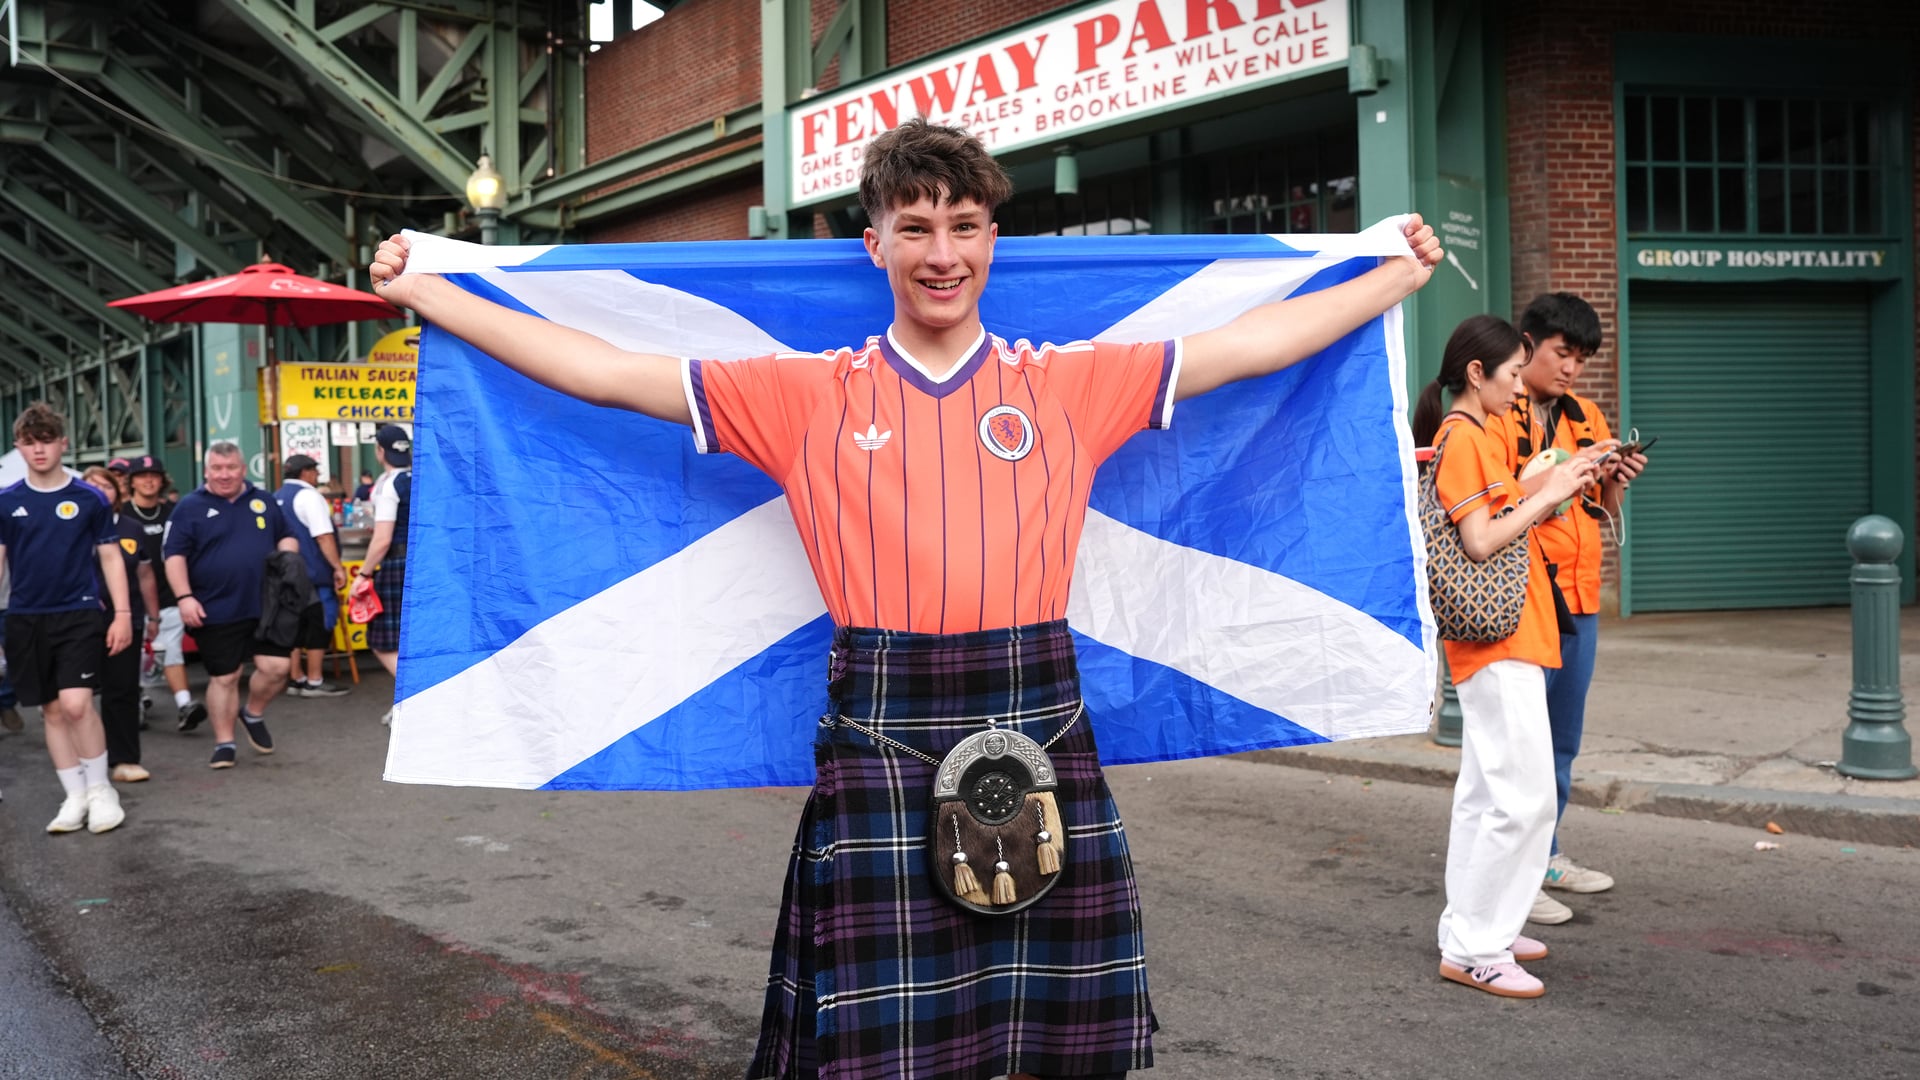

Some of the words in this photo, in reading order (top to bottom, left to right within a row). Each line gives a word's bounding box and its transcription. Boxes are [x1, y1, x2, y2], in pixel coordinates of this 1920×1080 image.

[801, 151, 843, 176] GAME
[961, 98, 1023, 129] SALES
[1055, 71, 1110, 103] GATE
[1125, 63, 1138, 83] E
[1175, 37, 1238, 68] WILL
[1252, 11, 1329, 47] CALL
[801, 33, 1050, 157] FENWAY
[801, 163, 864, 195] LANSD
[1035, 75, 1187, 132] BROOKLINE
[1205, 36, 1329, 87] AVENUE
[1637, 249, 1723, 267] GROUP
[1727, 249, 1886, 267] HOSPITALITY
[301, 367, 359, 382] ITALIAN
[367, 369, 417, 383] SAUSA
[313, 386, 409, 400] KIELBASA
[285, 422, 323, 437] Cash
[286, 437, 322, 449] Credit
